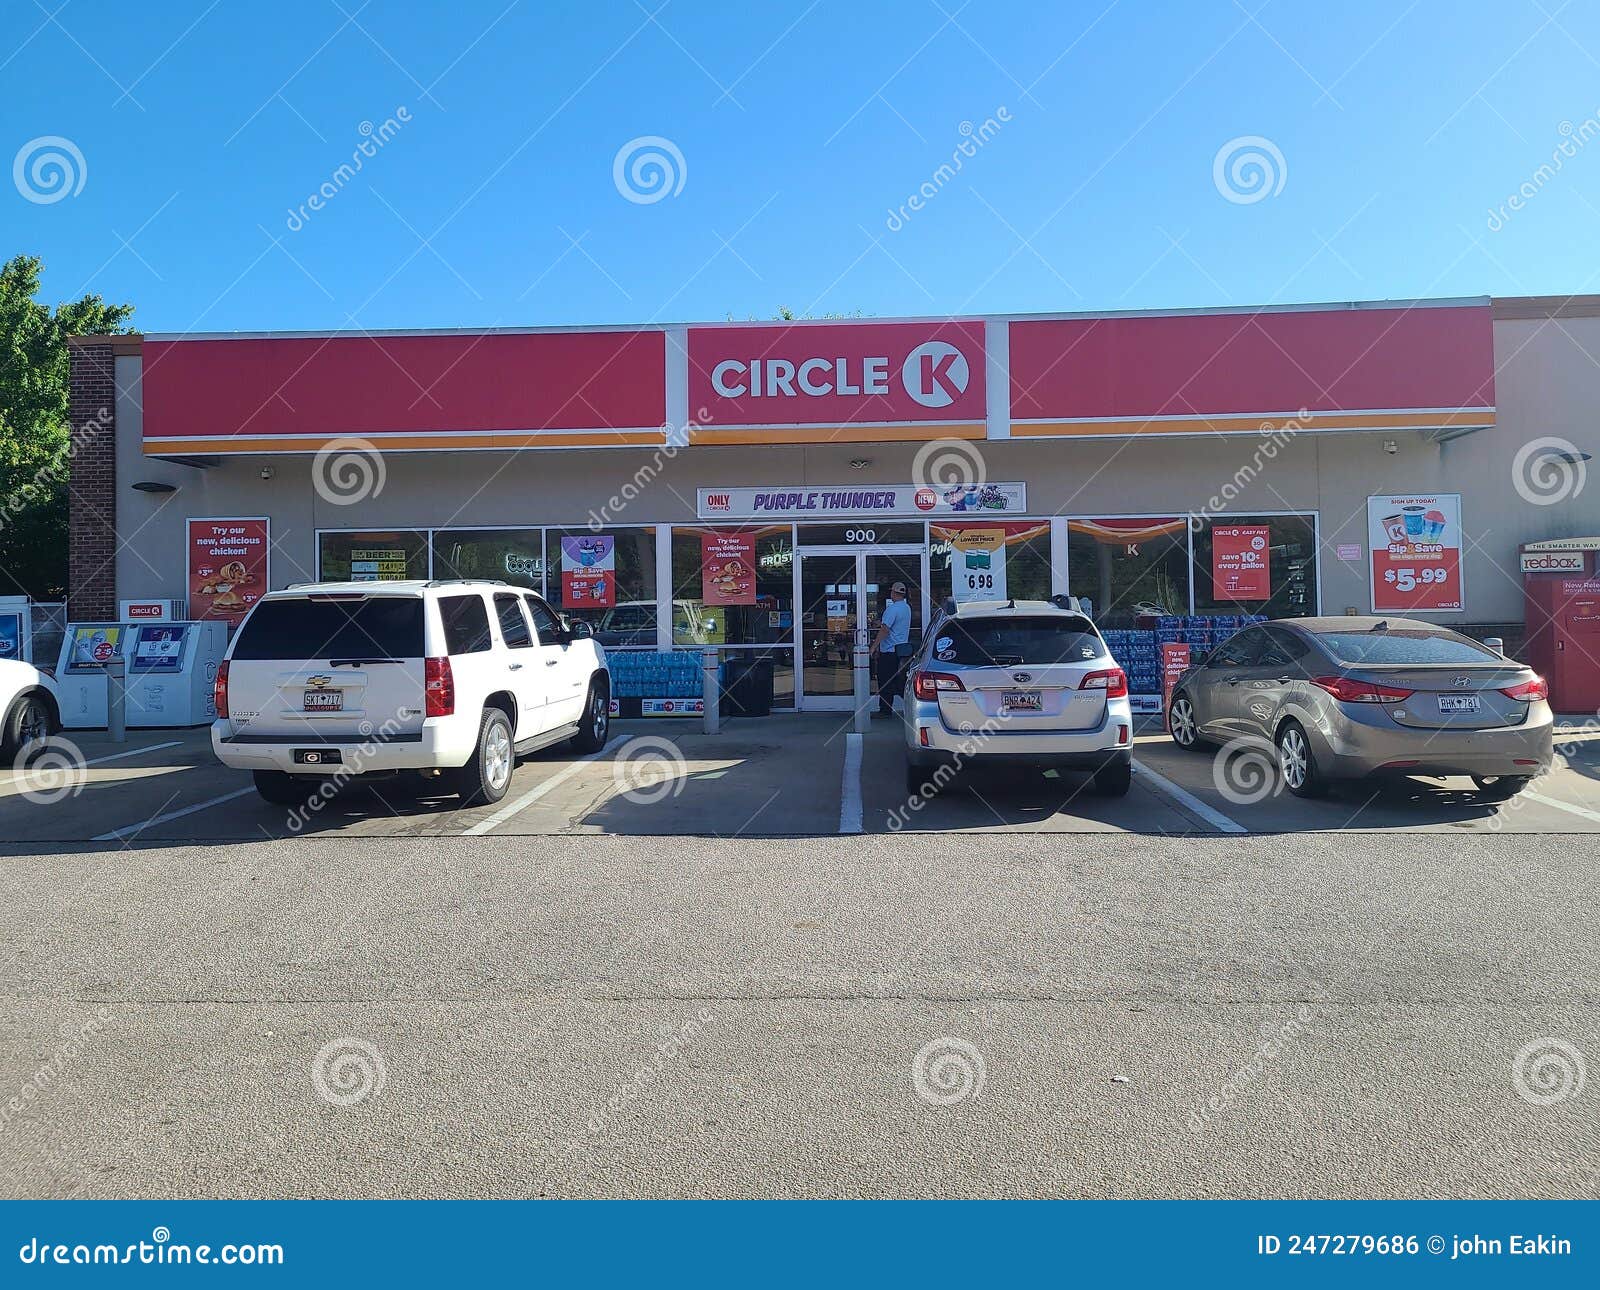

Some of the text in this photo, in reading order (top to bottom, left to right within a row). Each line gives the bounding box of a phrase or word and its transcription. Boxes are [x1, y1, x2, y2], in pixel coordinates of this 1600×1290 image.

[711, 348, 967, 405] CIRCLE K
[708, 495, 730, 505] ONLY
[753, 491, 896, 510] PURPLE THUNDER
[917, 494, 934, 505] NEW
[212, 527, 227, 535] Try
[846, 529, 875, 542] 900
[197, 537, 260, 546] new, delicious
[209, 547, 247, 555] chicken!
[1241, 562, 1265, 570] gallon
[1384, 568, 1447, 592] $5.99
[1025, 694, 1041, 706] 424
